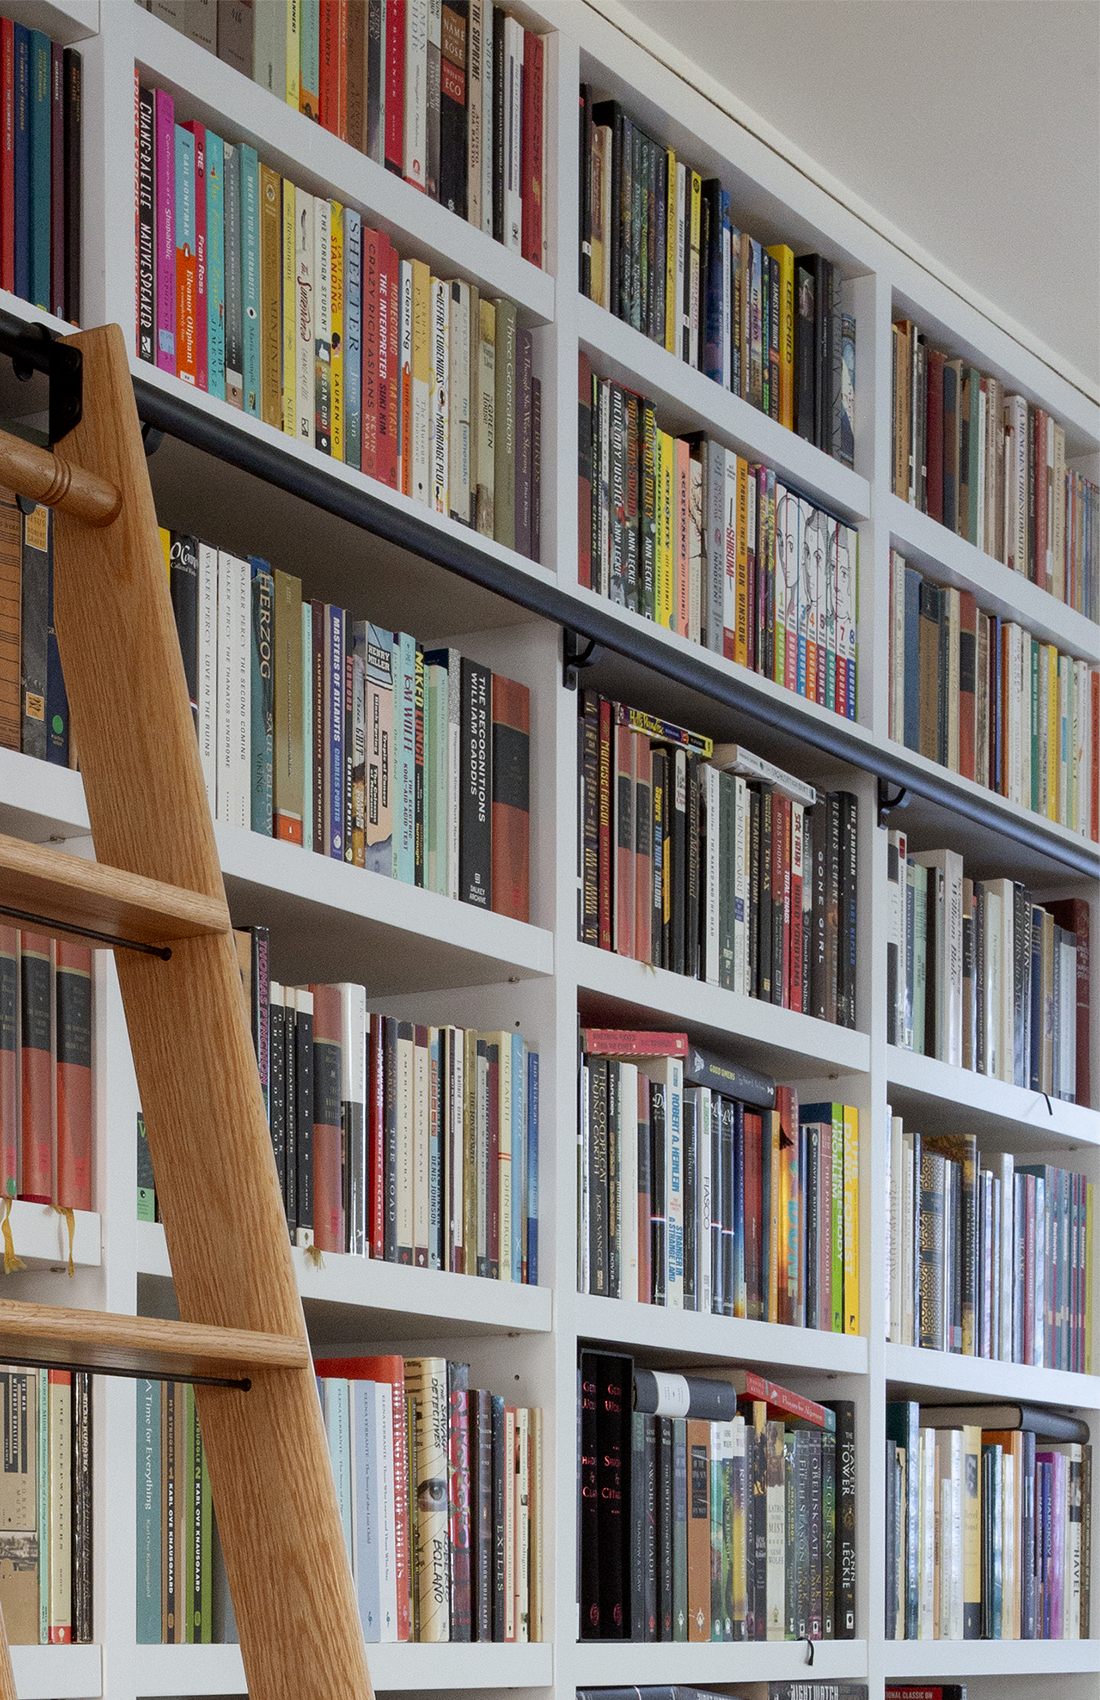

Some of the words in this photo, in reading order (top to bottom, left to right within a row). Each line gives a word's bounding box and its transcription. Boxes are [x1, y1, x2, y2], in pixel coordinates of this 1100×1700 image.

[445, 79, 462, 97] ECO
[140, 101, 152, 182] CHANG-RAE
[140, 183, 152, 210] LEE
[140, 222, 152, 268] NATIVE
[140, 270, 151, 328] SPEAKER
[349, 220, 359, 351] SHELTER
[379, 273, 387, 296] THE
[379, 298, 387, 379] INTERPRETER
[334, 427, 340, 445] HO
[436, 413, 444, 458] MARRIAGE
[435, 461, 444, 488] PLOT
[259, 573, 271, 679] HERZOG
[368, 644, 390, 658] HENRY
[368, 656, 390, 671] MILLER
[415, 651, 423, 709] NAKED
[470, 672, 478, 730] WILLIAM
[415, 710, 424, 766] LUNCH
[470, 737, 478, 796] GADDIS
[478, 708, 486, 822] RECOGNITIONS
[671, 1093, 679, 1131] ROBERT
[671, 1147, 679, 1192] HEINLEIN
[144, 1448, 152, 1510] Everything
